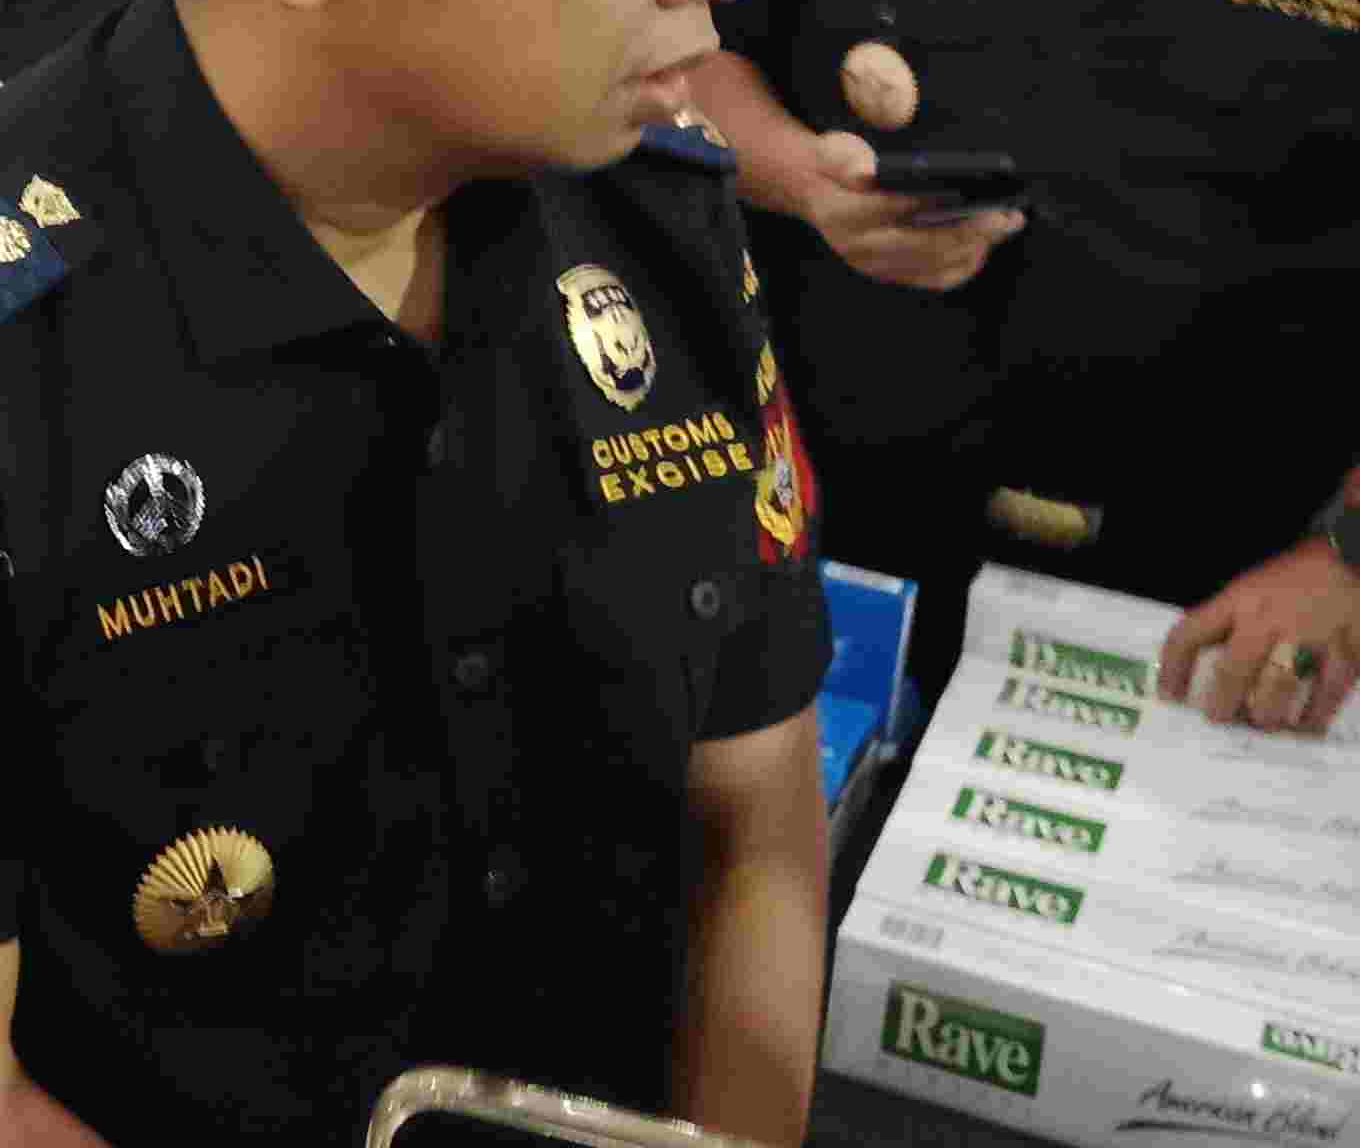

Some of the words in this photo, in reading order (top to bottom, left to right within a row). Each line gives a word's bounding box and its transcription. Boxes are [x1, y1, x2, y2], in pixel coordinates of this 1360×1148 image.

[96, 553, 270, 641] MUHTADI
[942, 852, 1071, 919] Rave
[898, 987, 1032, 1087] Rave
